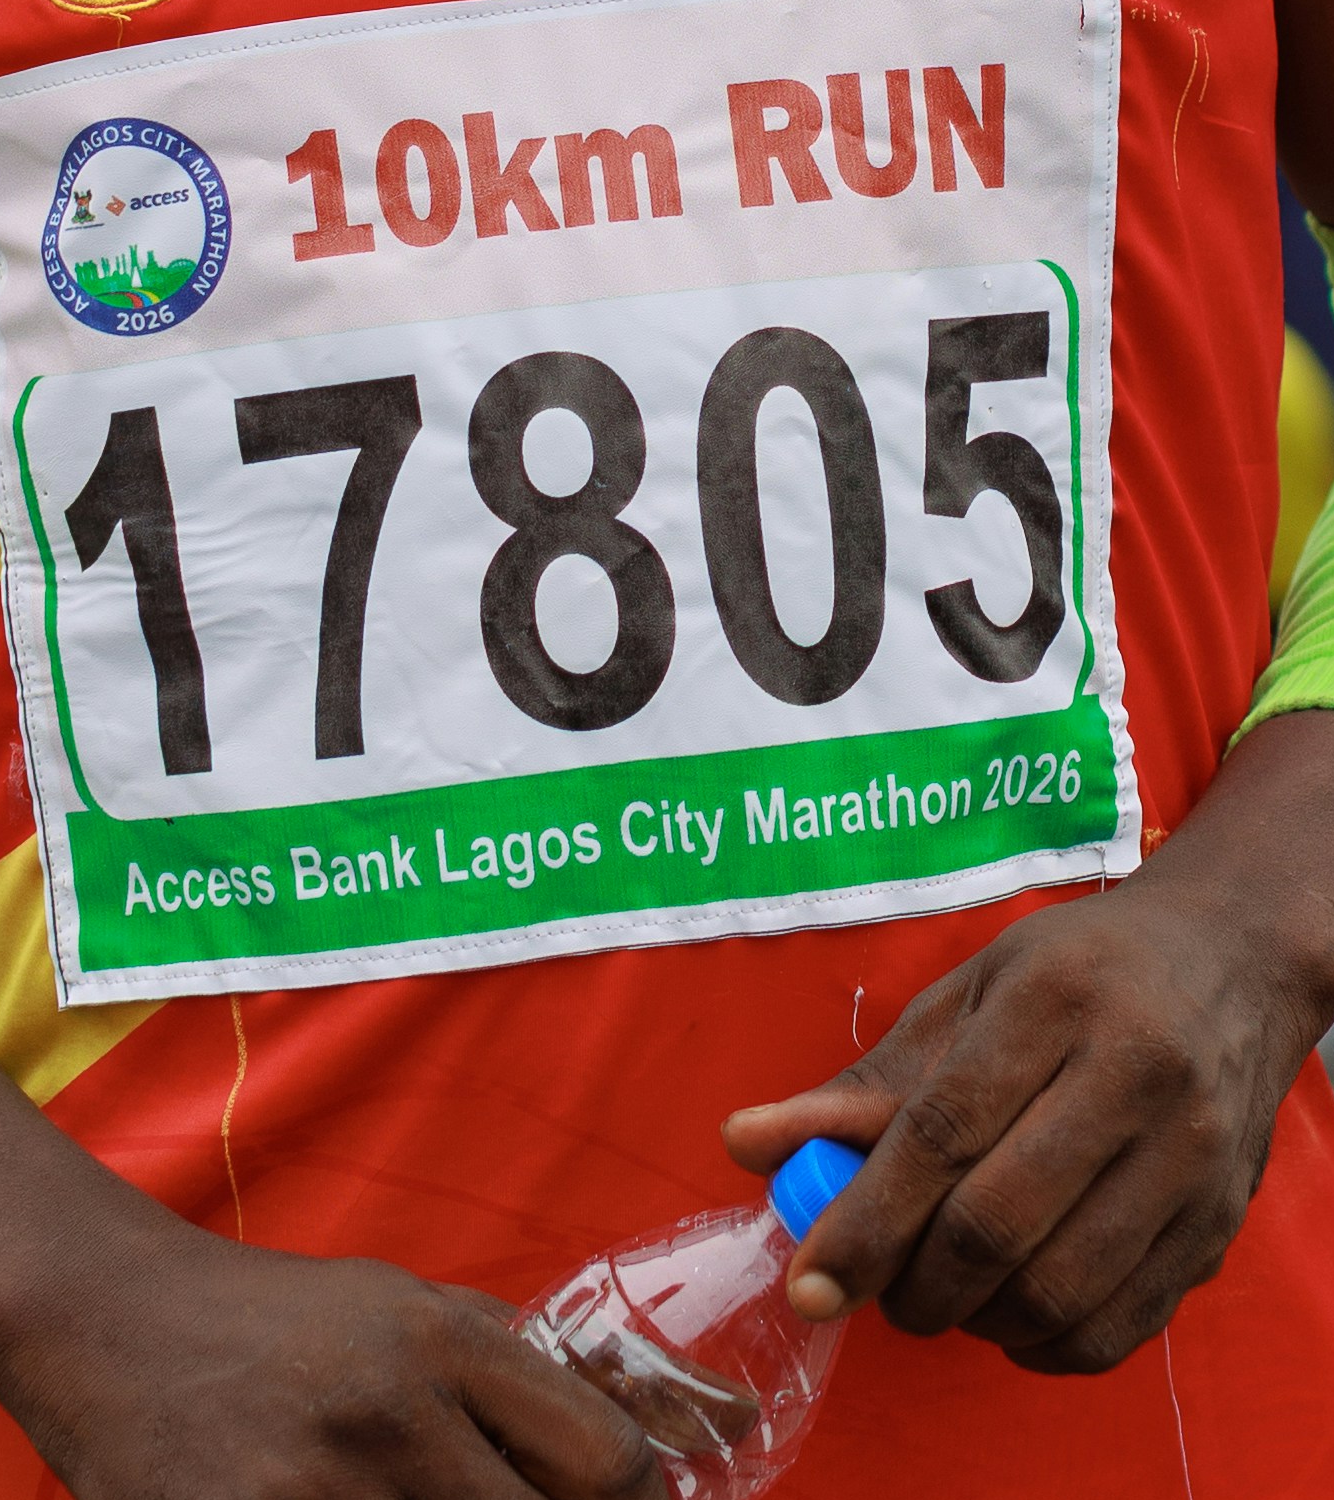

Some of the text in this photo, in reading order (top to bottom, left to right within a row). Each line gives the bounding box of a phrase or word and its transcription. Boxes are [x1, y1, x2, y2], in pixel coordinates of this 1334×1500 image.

[45, 125, 227, 314] ACCESS BANK LAGOS CITY MARATHON
[129, 188, 190, 211] access
[286, 63, 1008, 262] 10km RUN
[116, 304, 175, 332] 2026
[64, 310, 1066, 776] 17805
[124, 750, 1083, 916] Access Bank Lagos City Marathon 2026
